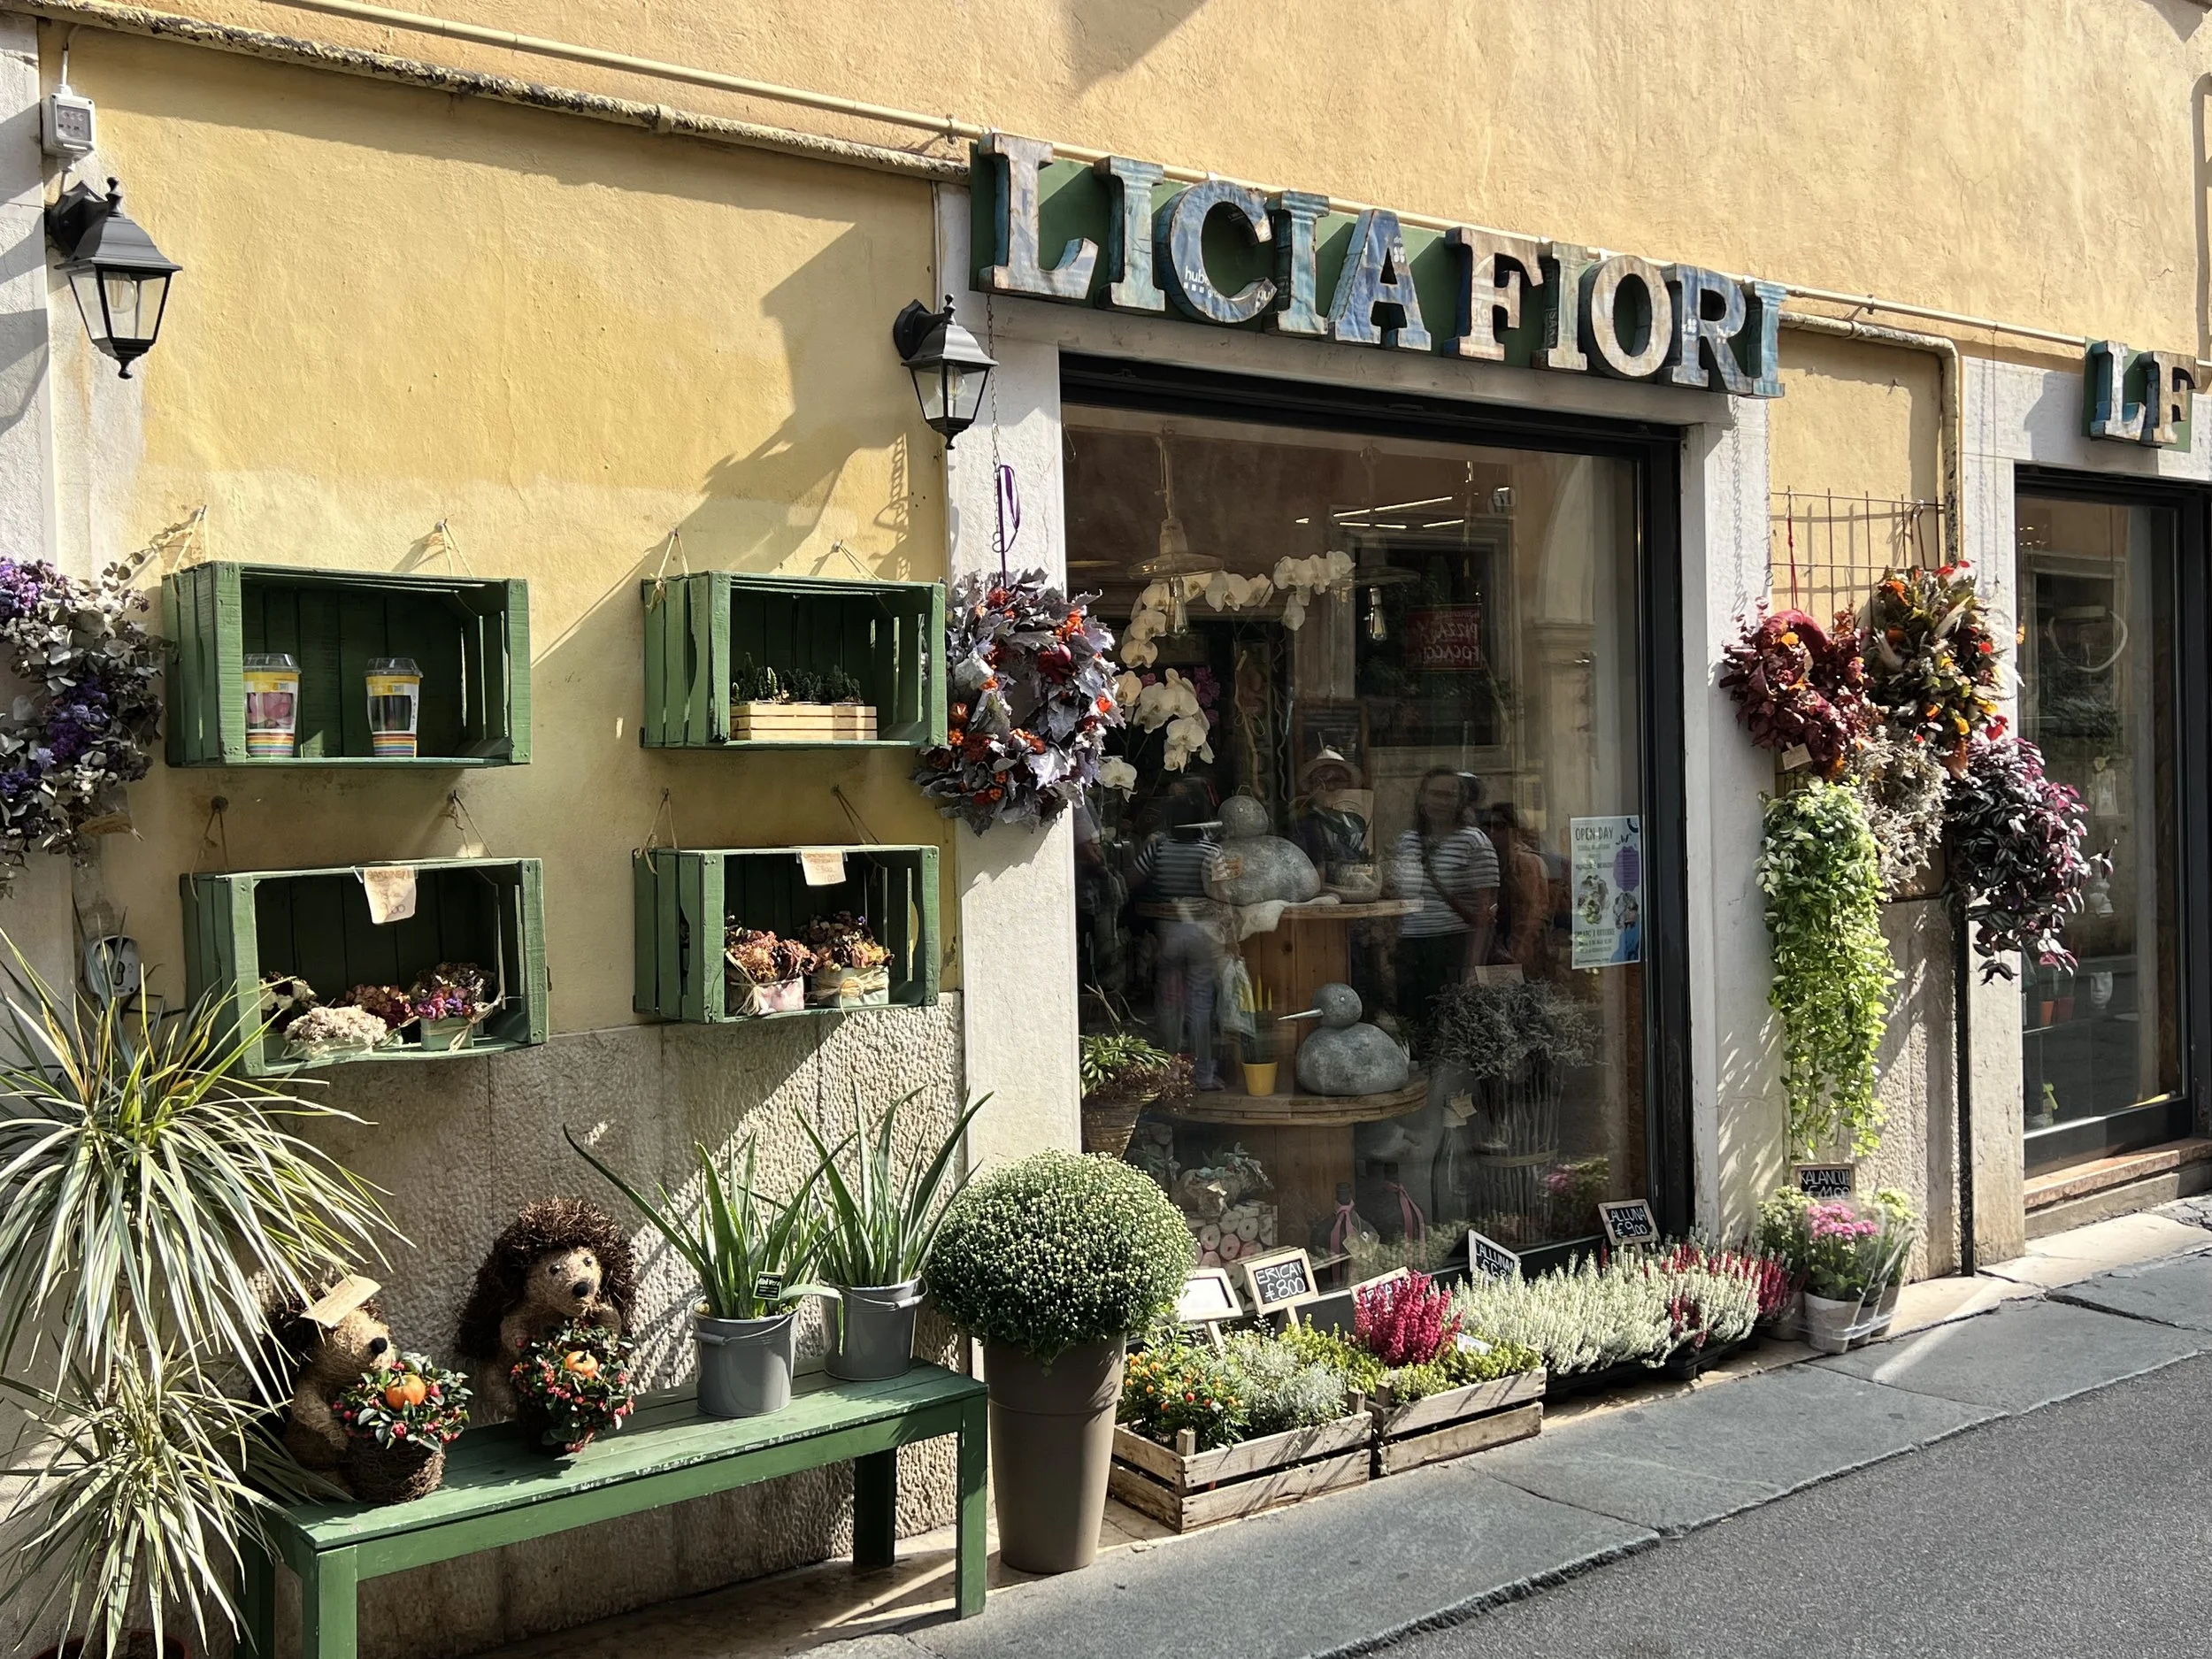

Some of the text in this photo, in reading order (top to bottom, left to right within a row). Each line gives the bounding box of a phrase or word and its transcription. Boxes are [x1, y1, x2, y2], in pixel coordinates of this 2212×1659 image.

[979, 133, 1786, 397] LICIA FIORI
[1575, 826, 1614, 841] OPEN DAY
